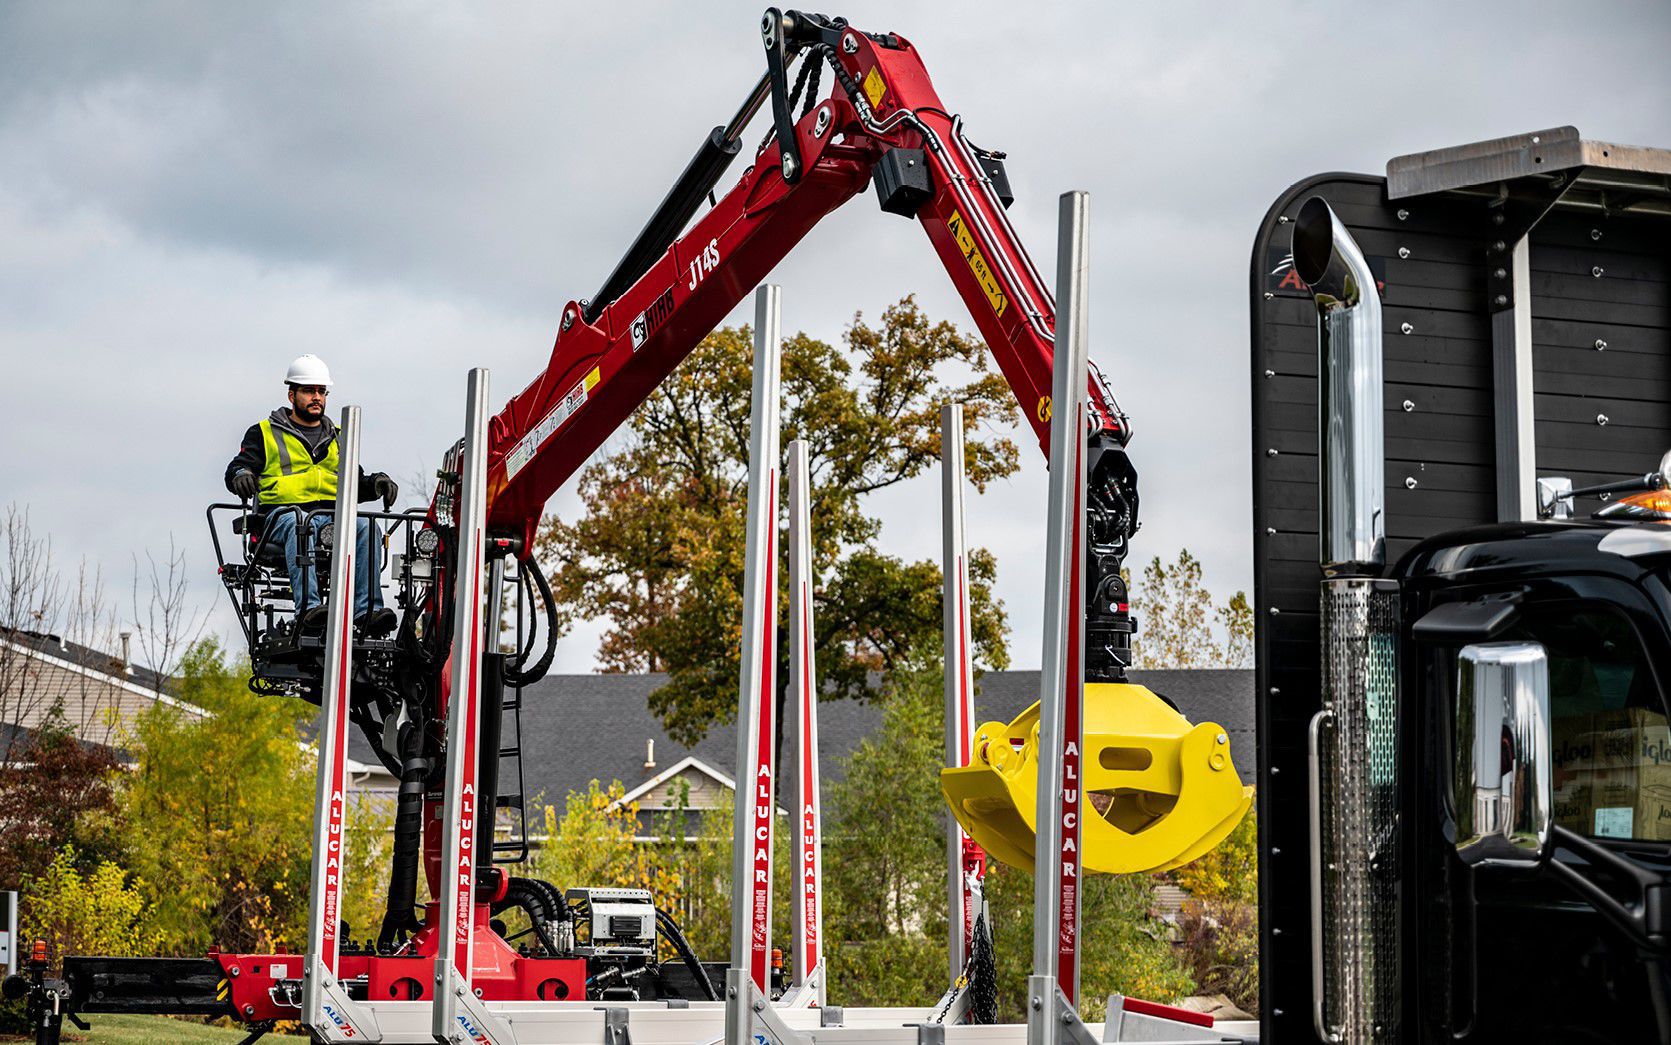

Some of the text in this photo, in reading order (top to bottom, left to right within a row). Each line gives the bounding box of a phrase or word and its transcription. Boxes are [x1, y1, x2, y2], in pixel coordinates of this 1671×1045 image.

[689, 238, 720, 291] J14S
[975, 260, 983, 273] 65
[644, 287, 675, 335] HIAB
[1552, 740, 1592, 768] gloo
[1641, 735, 1671, 766] iglo
[459, 783, 474, 886] ALUCAR
[755, 764, 771, 883] ALUCAR
[1062, 741, 1079, 878] ALUCAR
[327, 790, 342, 886] ALUCAR
[804, 804, 816, 893] ALUCAR
[323, 1004, 356, 1039] ALU75
